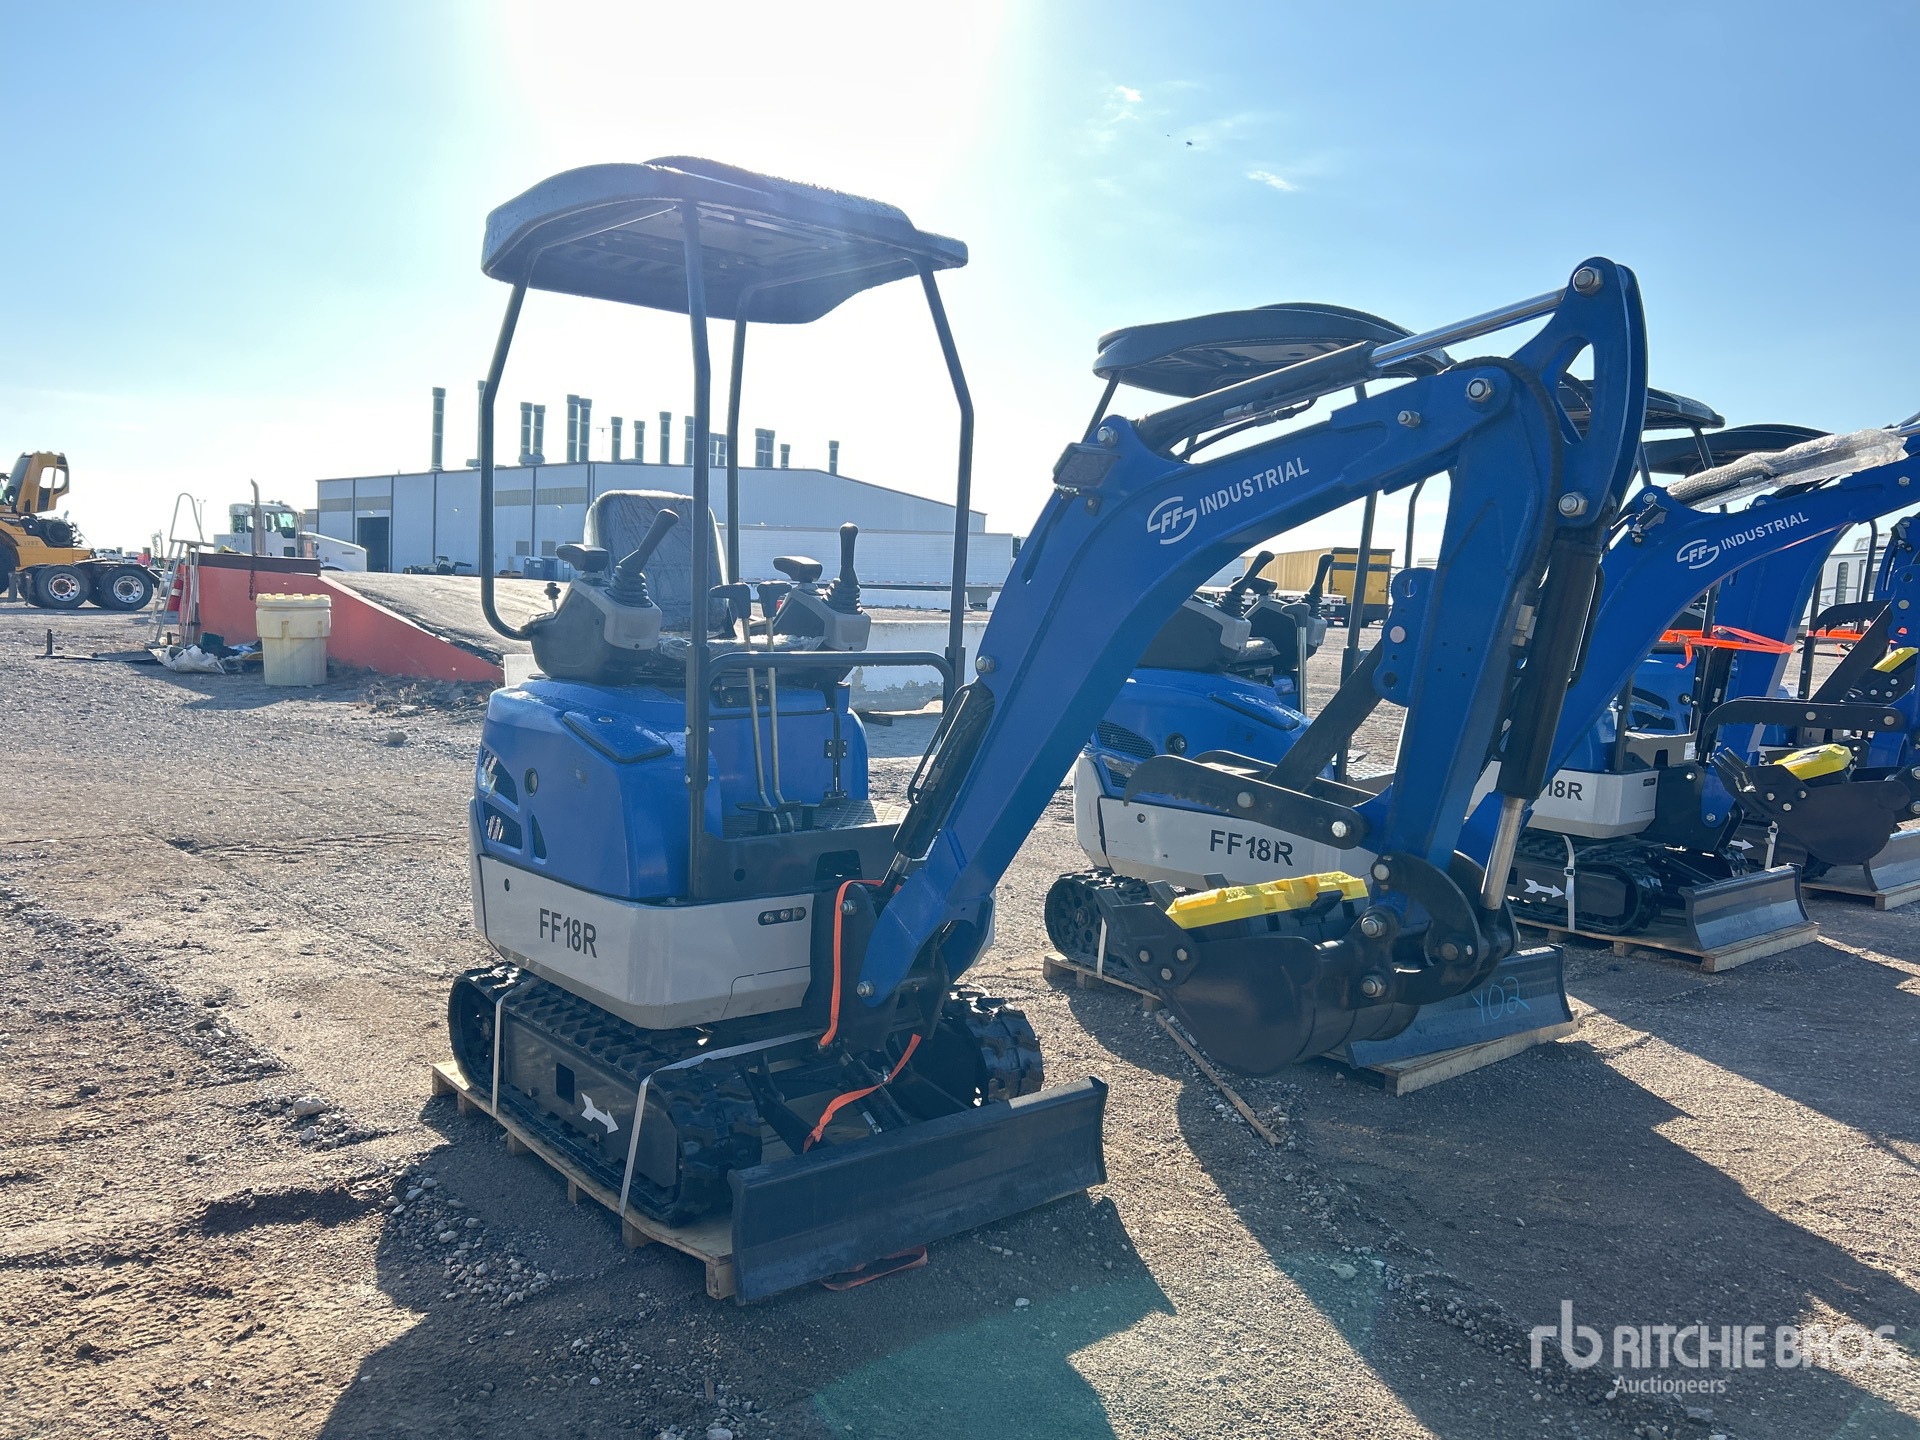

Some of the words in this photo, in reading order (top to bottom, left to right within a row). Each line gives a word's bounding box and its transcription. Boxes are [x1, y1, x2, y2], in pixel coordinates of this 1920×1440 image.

[1199, 456, 1310, 516] INDUSTRIAL
[1720, 511, 1809, 551] INDUSTRIAL
[1210, 829, 1294, 867] FF18R
[540, 907, 598, 959] FF18R
